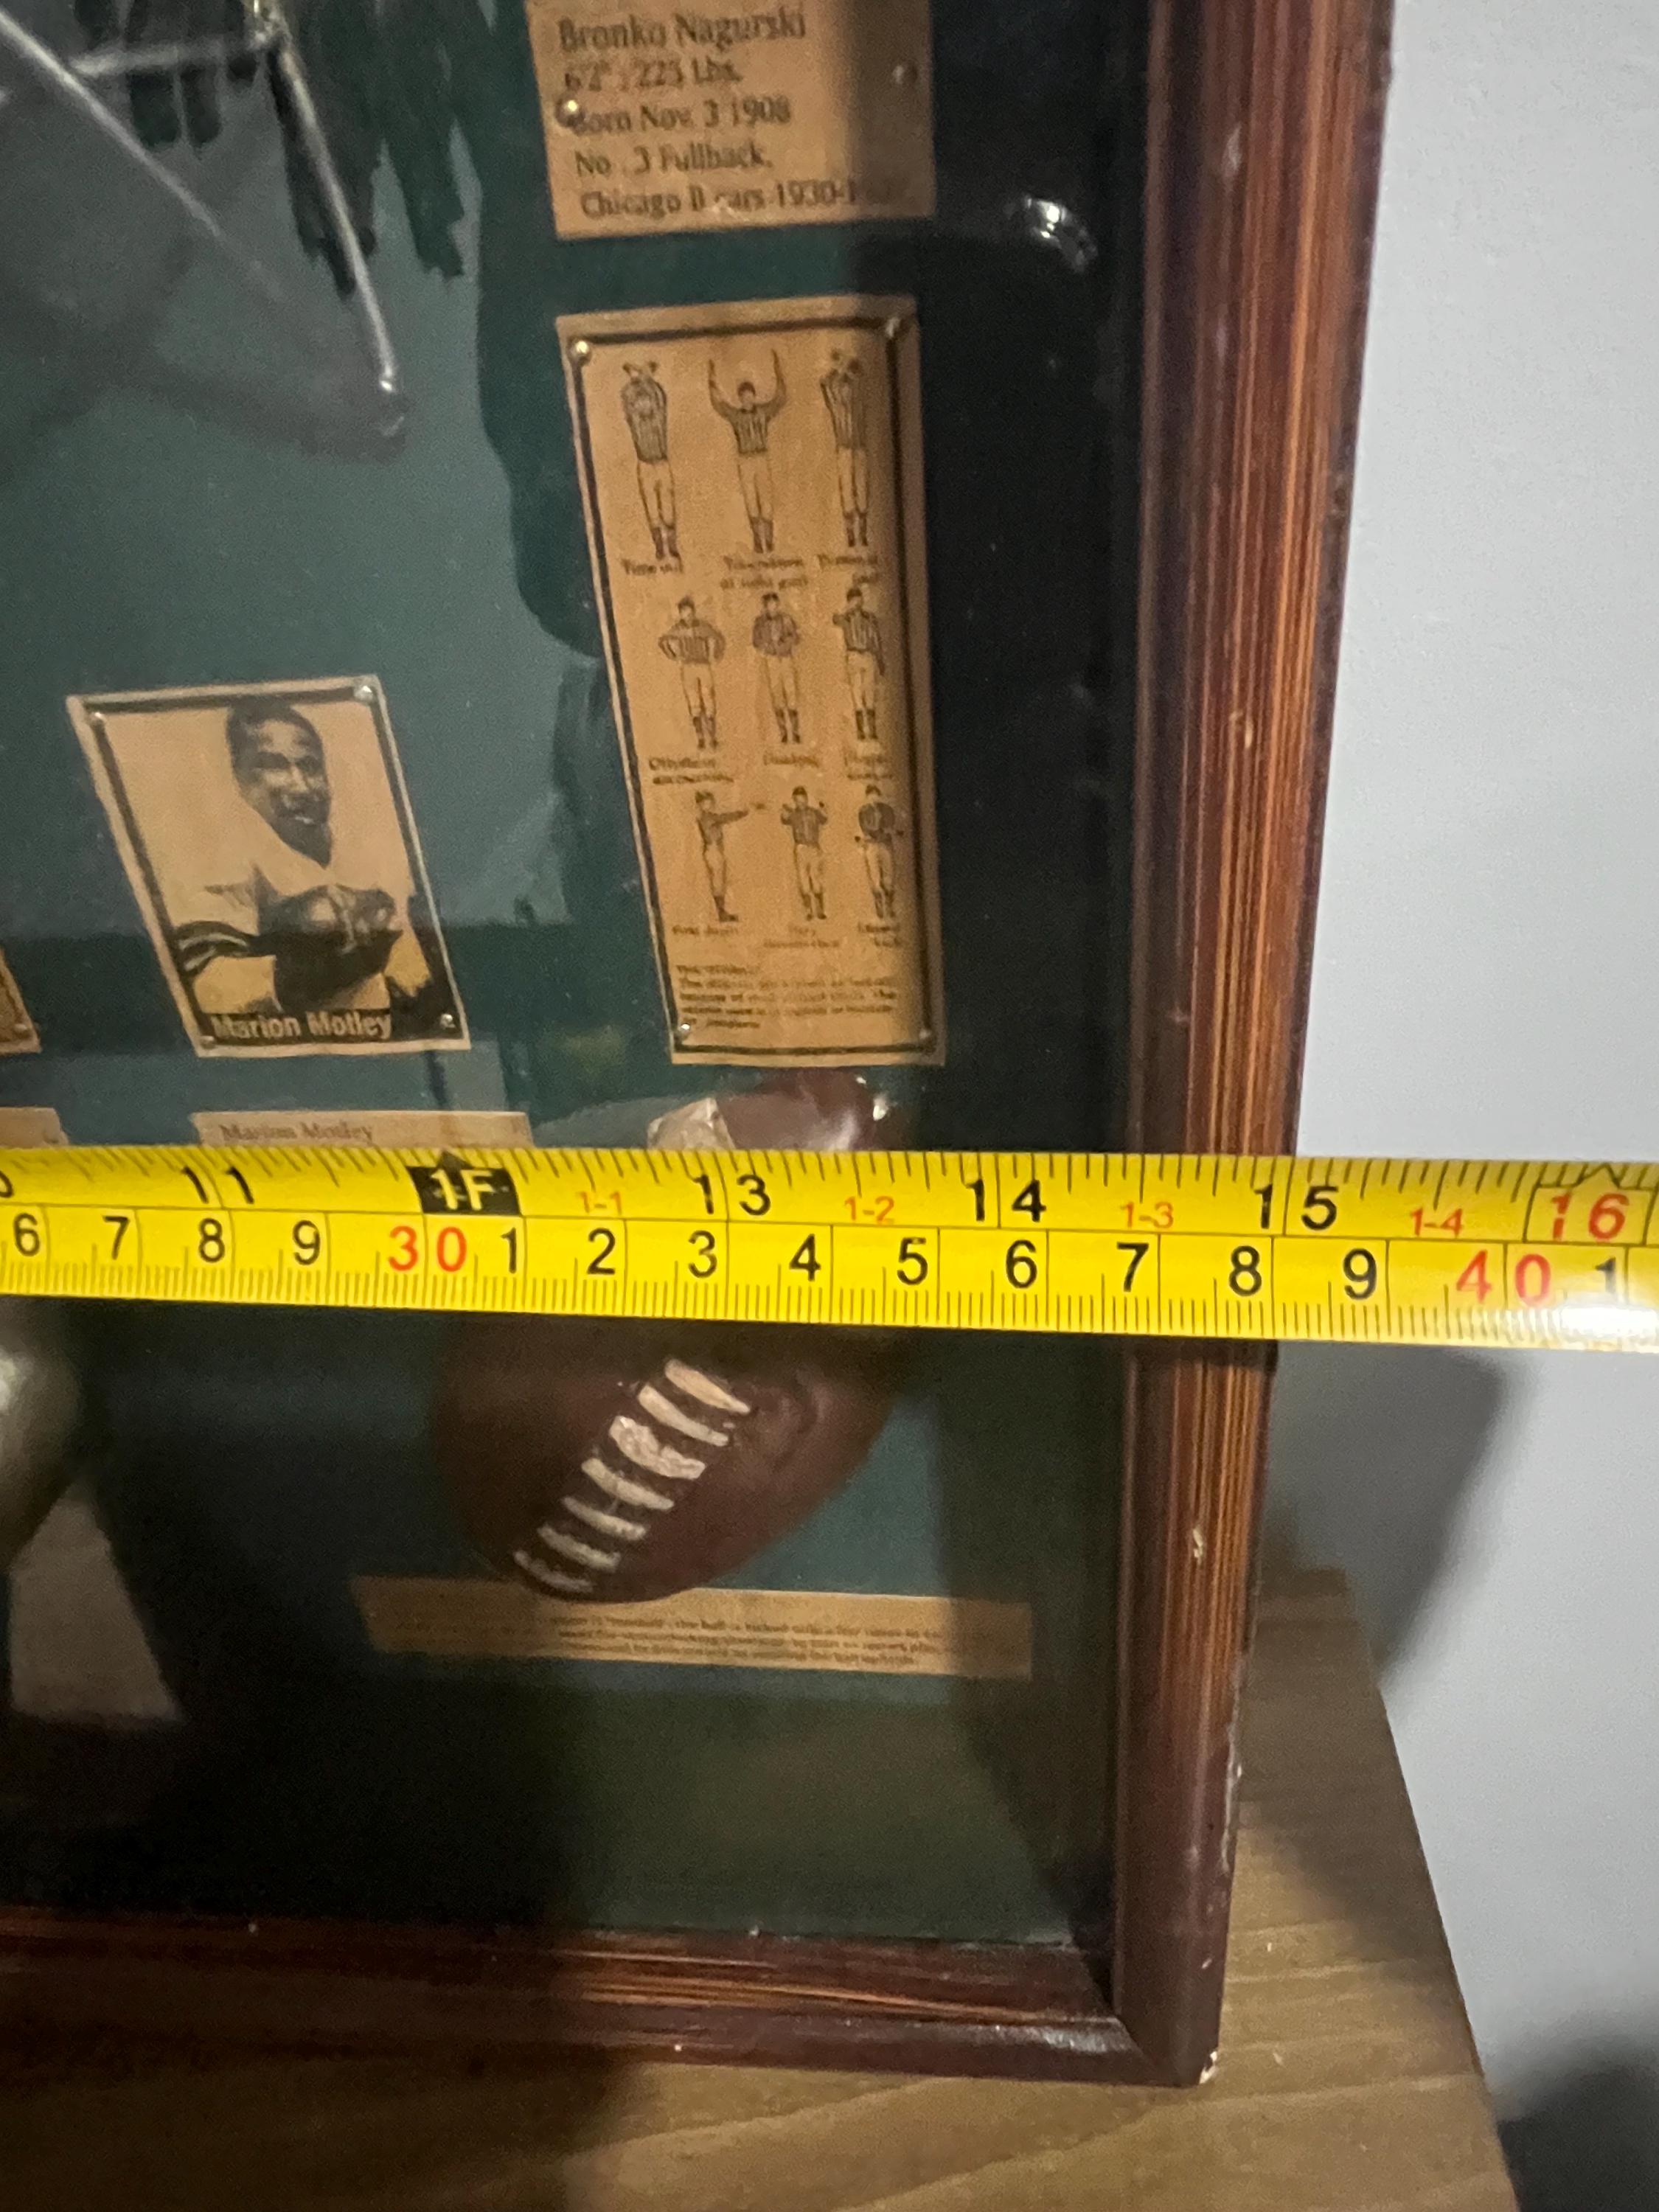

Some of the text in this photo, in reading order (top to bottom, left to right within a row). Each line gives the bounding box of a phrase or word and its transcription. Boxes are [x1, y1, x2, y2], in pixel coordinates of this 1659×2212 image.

[558, 7, 806, 52] Bronko Nagurski
[580, 191, 681, 220] Chicago
[209, 1010, 391, 1040] Marion Motley
[182, 1166, 255, 1205] 11
[431, 1169, 493, 1210] 1F
[578, 1190, 622, 1216] 1-1
[691, 1174, 771, 1217] 13
[965, 1178, 1047, 1222] 14
[1253, 1185, 1338, 1231] 15
[844, 1196, 895, 1225] 1-2
[1120, 1200, 1175, 1230] 1-3
[1411, 1207, 1464, 1237] 1-4
[1550, 1192, 1629, 1242] 16
[13, 1212, 41, 1256] 6
[102, 1215, 130, 1260] 7
[198, 1218, 226, 1264] 8
[293, 1220, 321, 1266] 9
[388, 1225, 467, 1273] 30
[500, 1228, 518, 1274] 1
[586, 1228, 616, 1276] 2
[687, 1230, 717, 1279] 3
[789, 1234, 821, 1281] 4
[897, 1237, 928, 1285] 5
[1005, 1239, 1037, 1289] 6
[1116, 1242, 1149, 1293] 7
[1228, 1245, 1262, 1297] 8
[1343, 1248, 1377, 1300] 9
[1455, 1249, 1552, 1306] 40
[1594, 1257, 1618, 1295] 1
